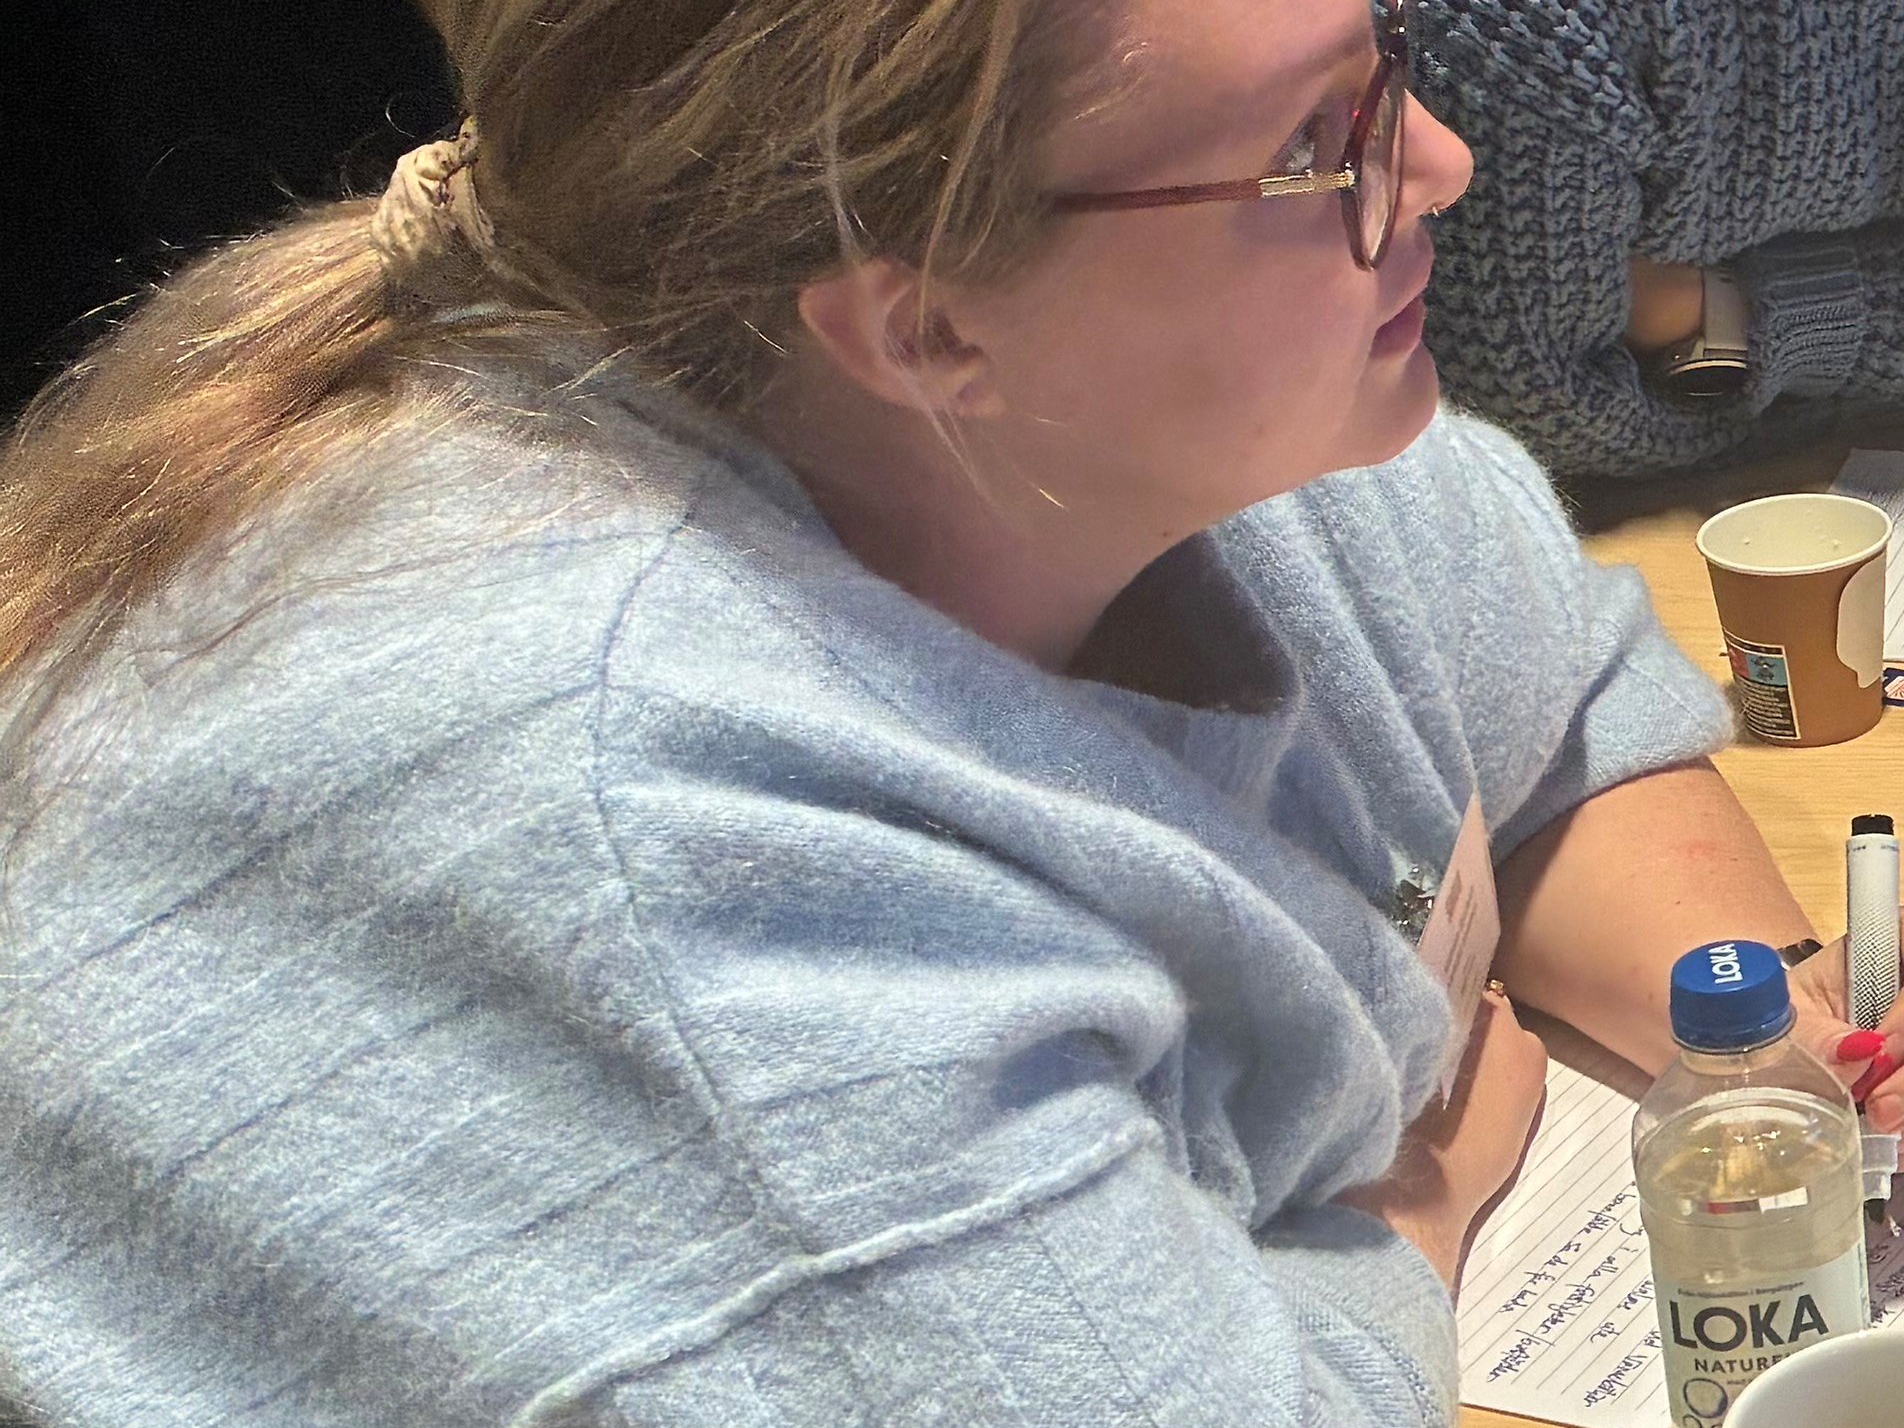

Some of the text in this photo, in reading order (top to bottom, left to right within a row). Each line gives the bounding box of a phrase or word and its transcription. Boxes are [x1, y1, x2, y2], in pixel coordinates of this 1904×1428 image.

[1708, 944, 1744, 985] LOKA
[1669, 1293, 1830, 1353] LOKA
[1694, 1352, 1790, 1374] NATURE
